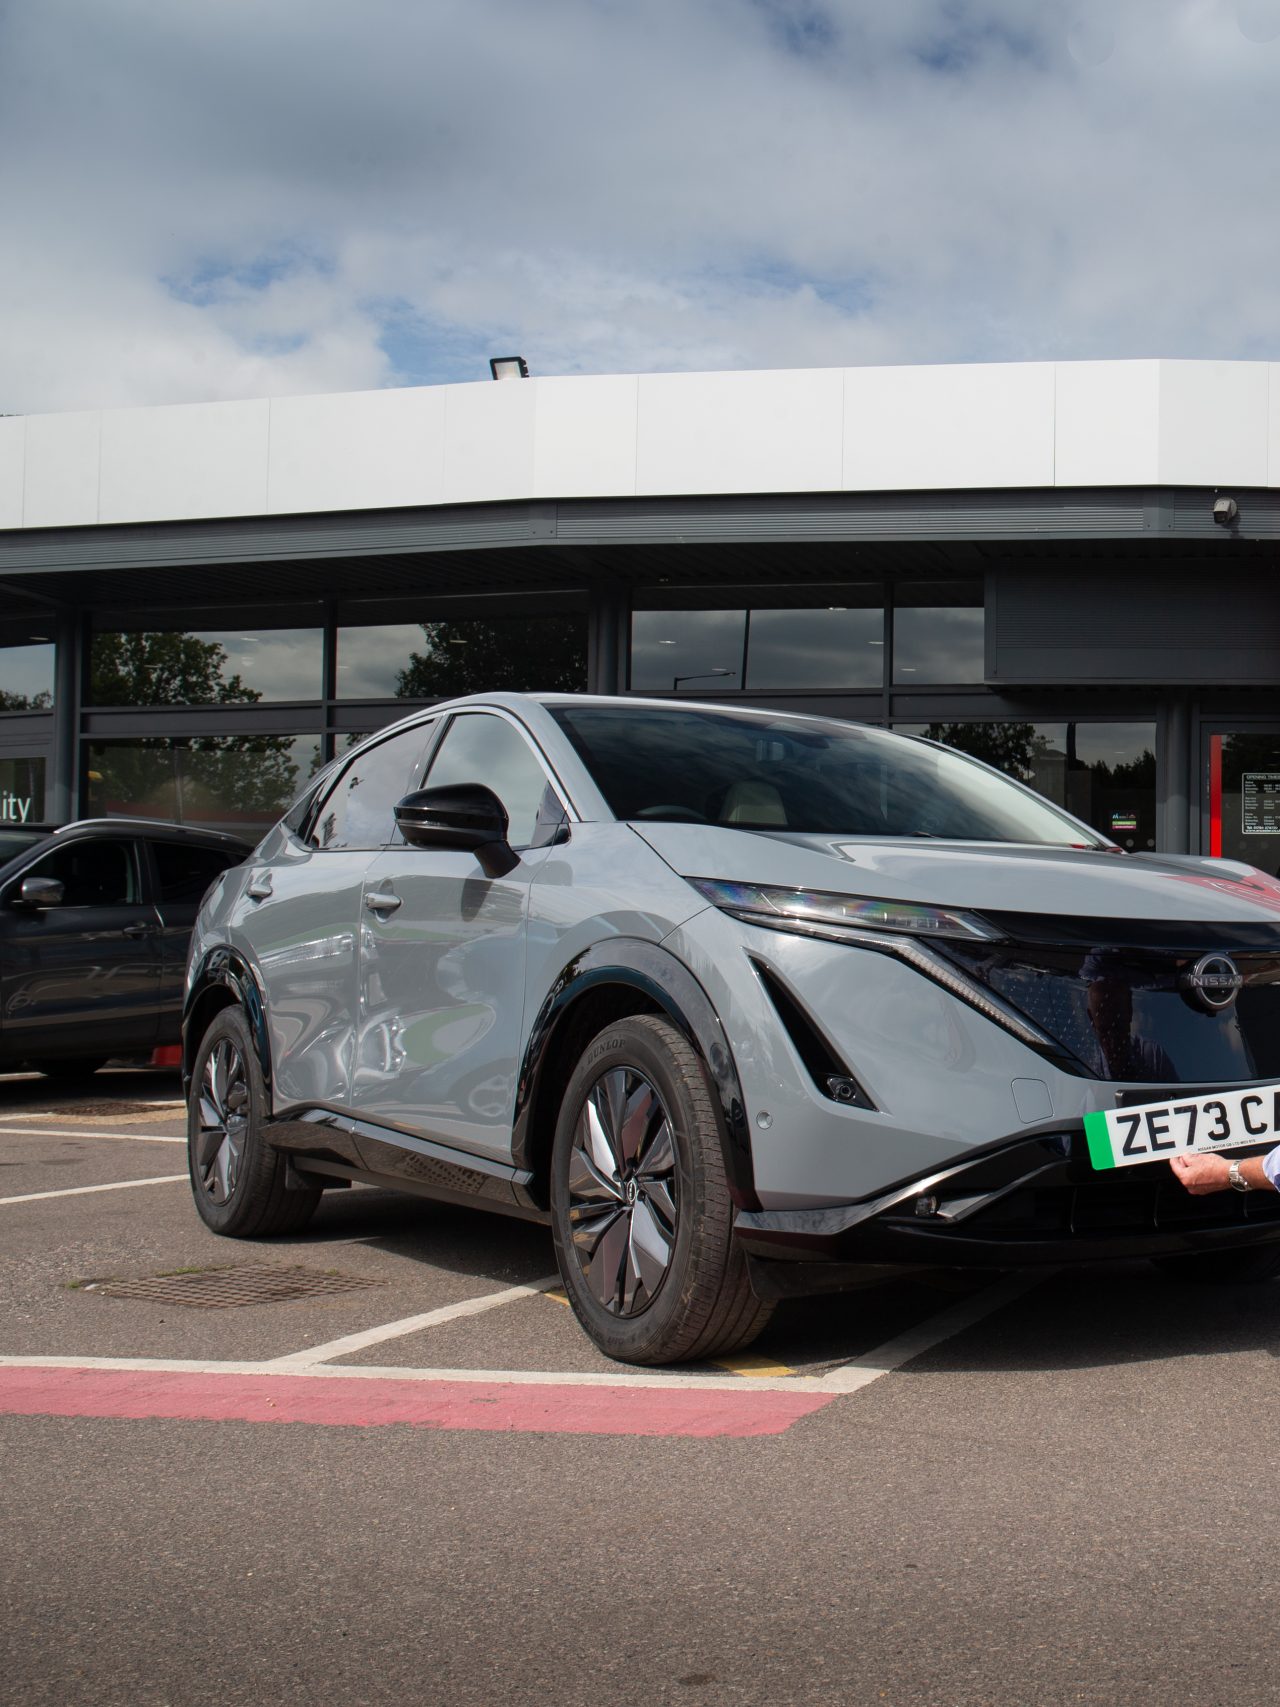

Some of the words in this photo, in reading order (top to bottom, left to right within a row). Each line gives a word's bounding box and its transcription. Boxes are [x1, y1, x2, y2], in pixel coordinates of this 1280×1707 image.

[0, 790, 31, 823] ity
[1192, 975, 1243, 987] NISSAN
[587, 1039, 626, 1066] DUNLOP
[1116, 1100, 1231, 1157] ZE73
